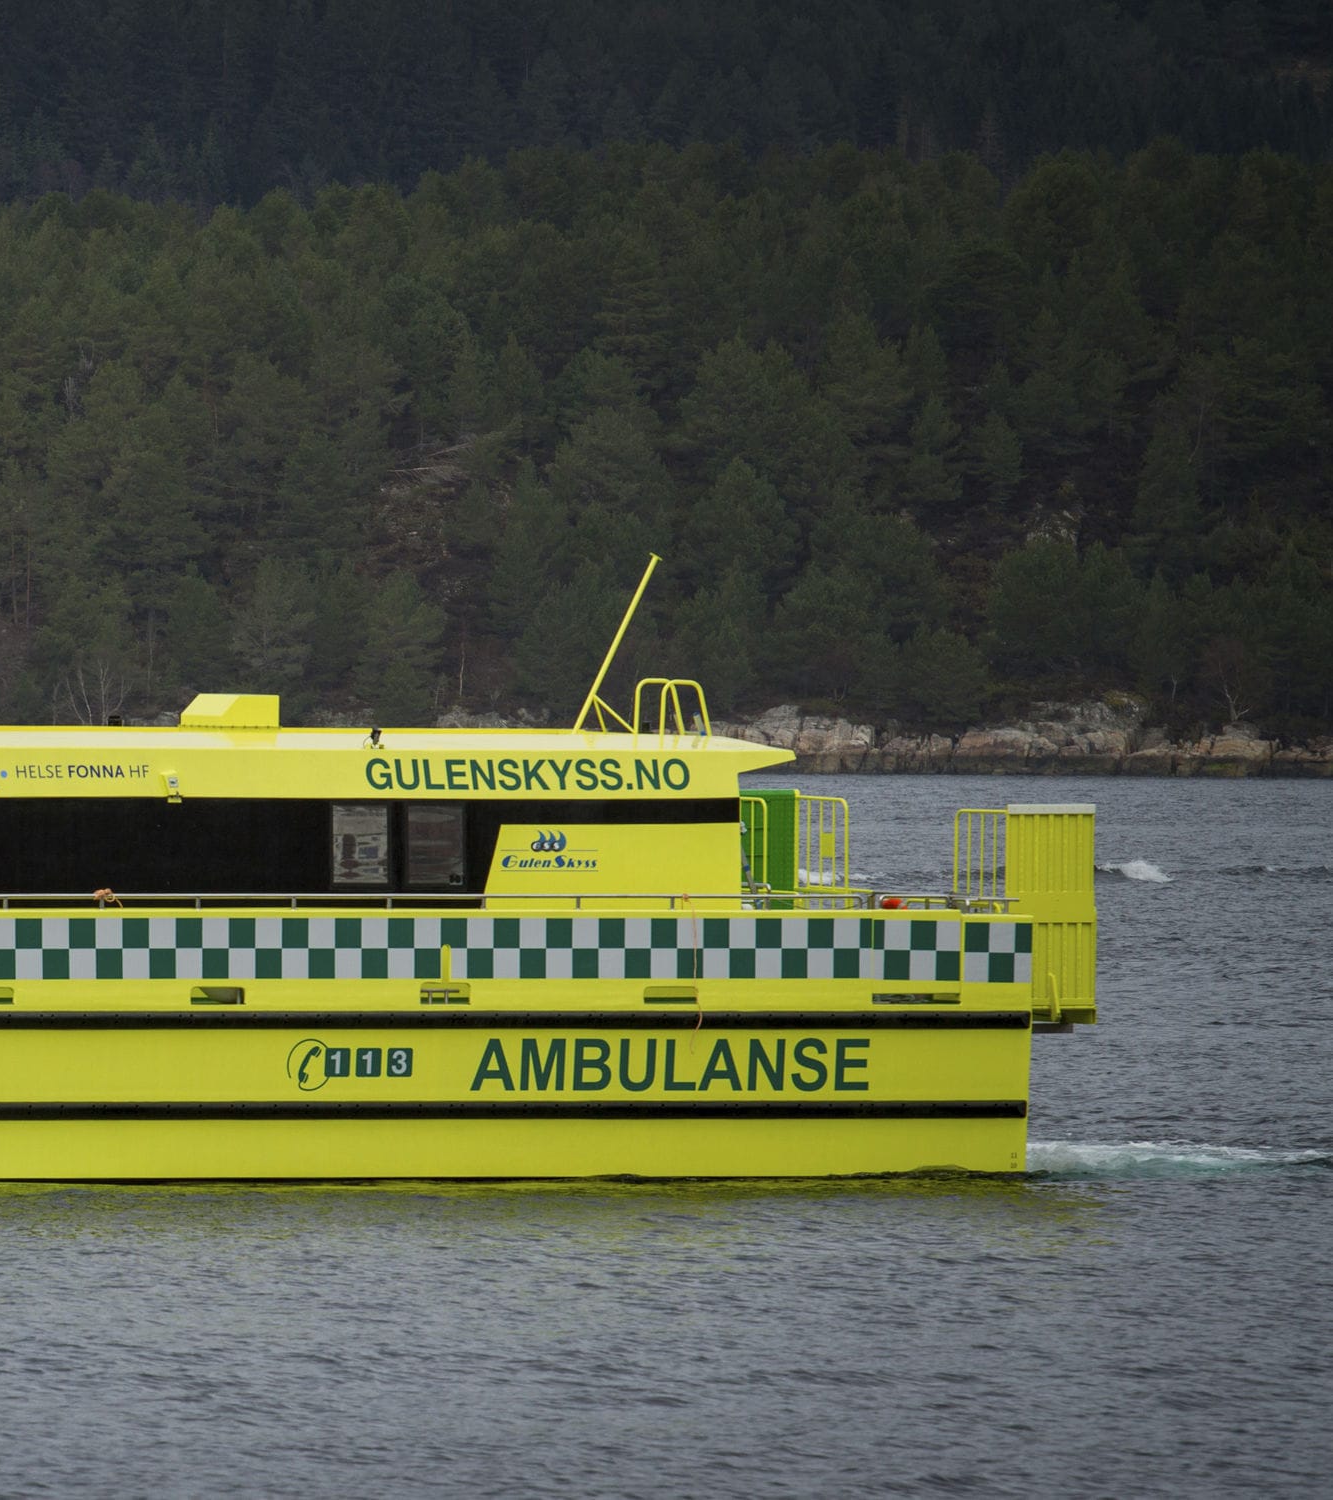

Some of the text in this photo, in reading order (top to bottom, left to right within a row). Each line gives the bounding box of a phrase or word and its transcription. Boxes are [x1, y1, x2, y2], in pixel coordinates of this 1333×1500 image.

[15, 764, 150, 779] HELSE FONNA HF
[365, 757, 691, 791] GULENSKYSS.NO
[469, 1037, 872, 1092] AMBULANSE
